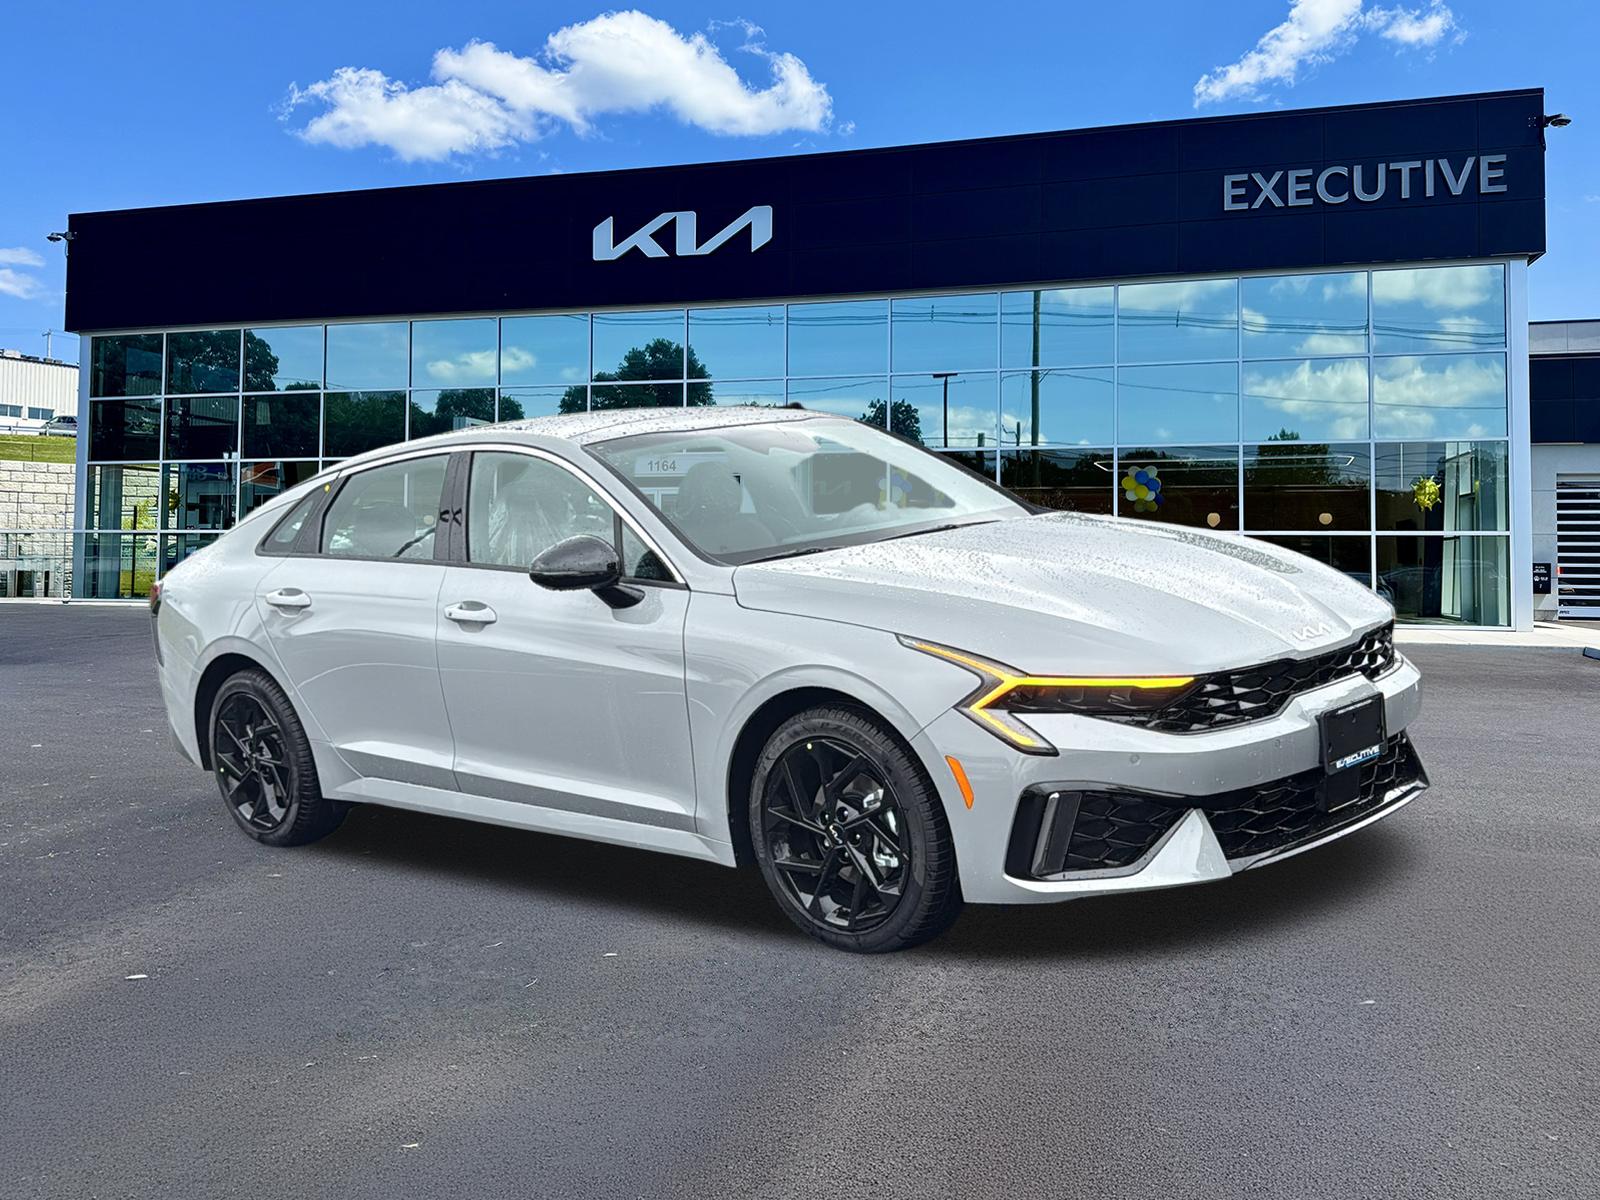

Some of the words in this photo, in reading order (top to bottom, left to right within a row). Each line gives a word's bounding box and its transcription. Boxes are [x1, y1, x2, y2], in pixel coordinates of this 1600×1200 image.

[1223, 154, 1508, 211] EXECUTIVE
[593, 205, 773, 261] KIA
[647, 460, 677, 472] 1164
[1291, 622, 1331, 641] KIA
[1336, 744, 1380, 769] EXECUTIVE
